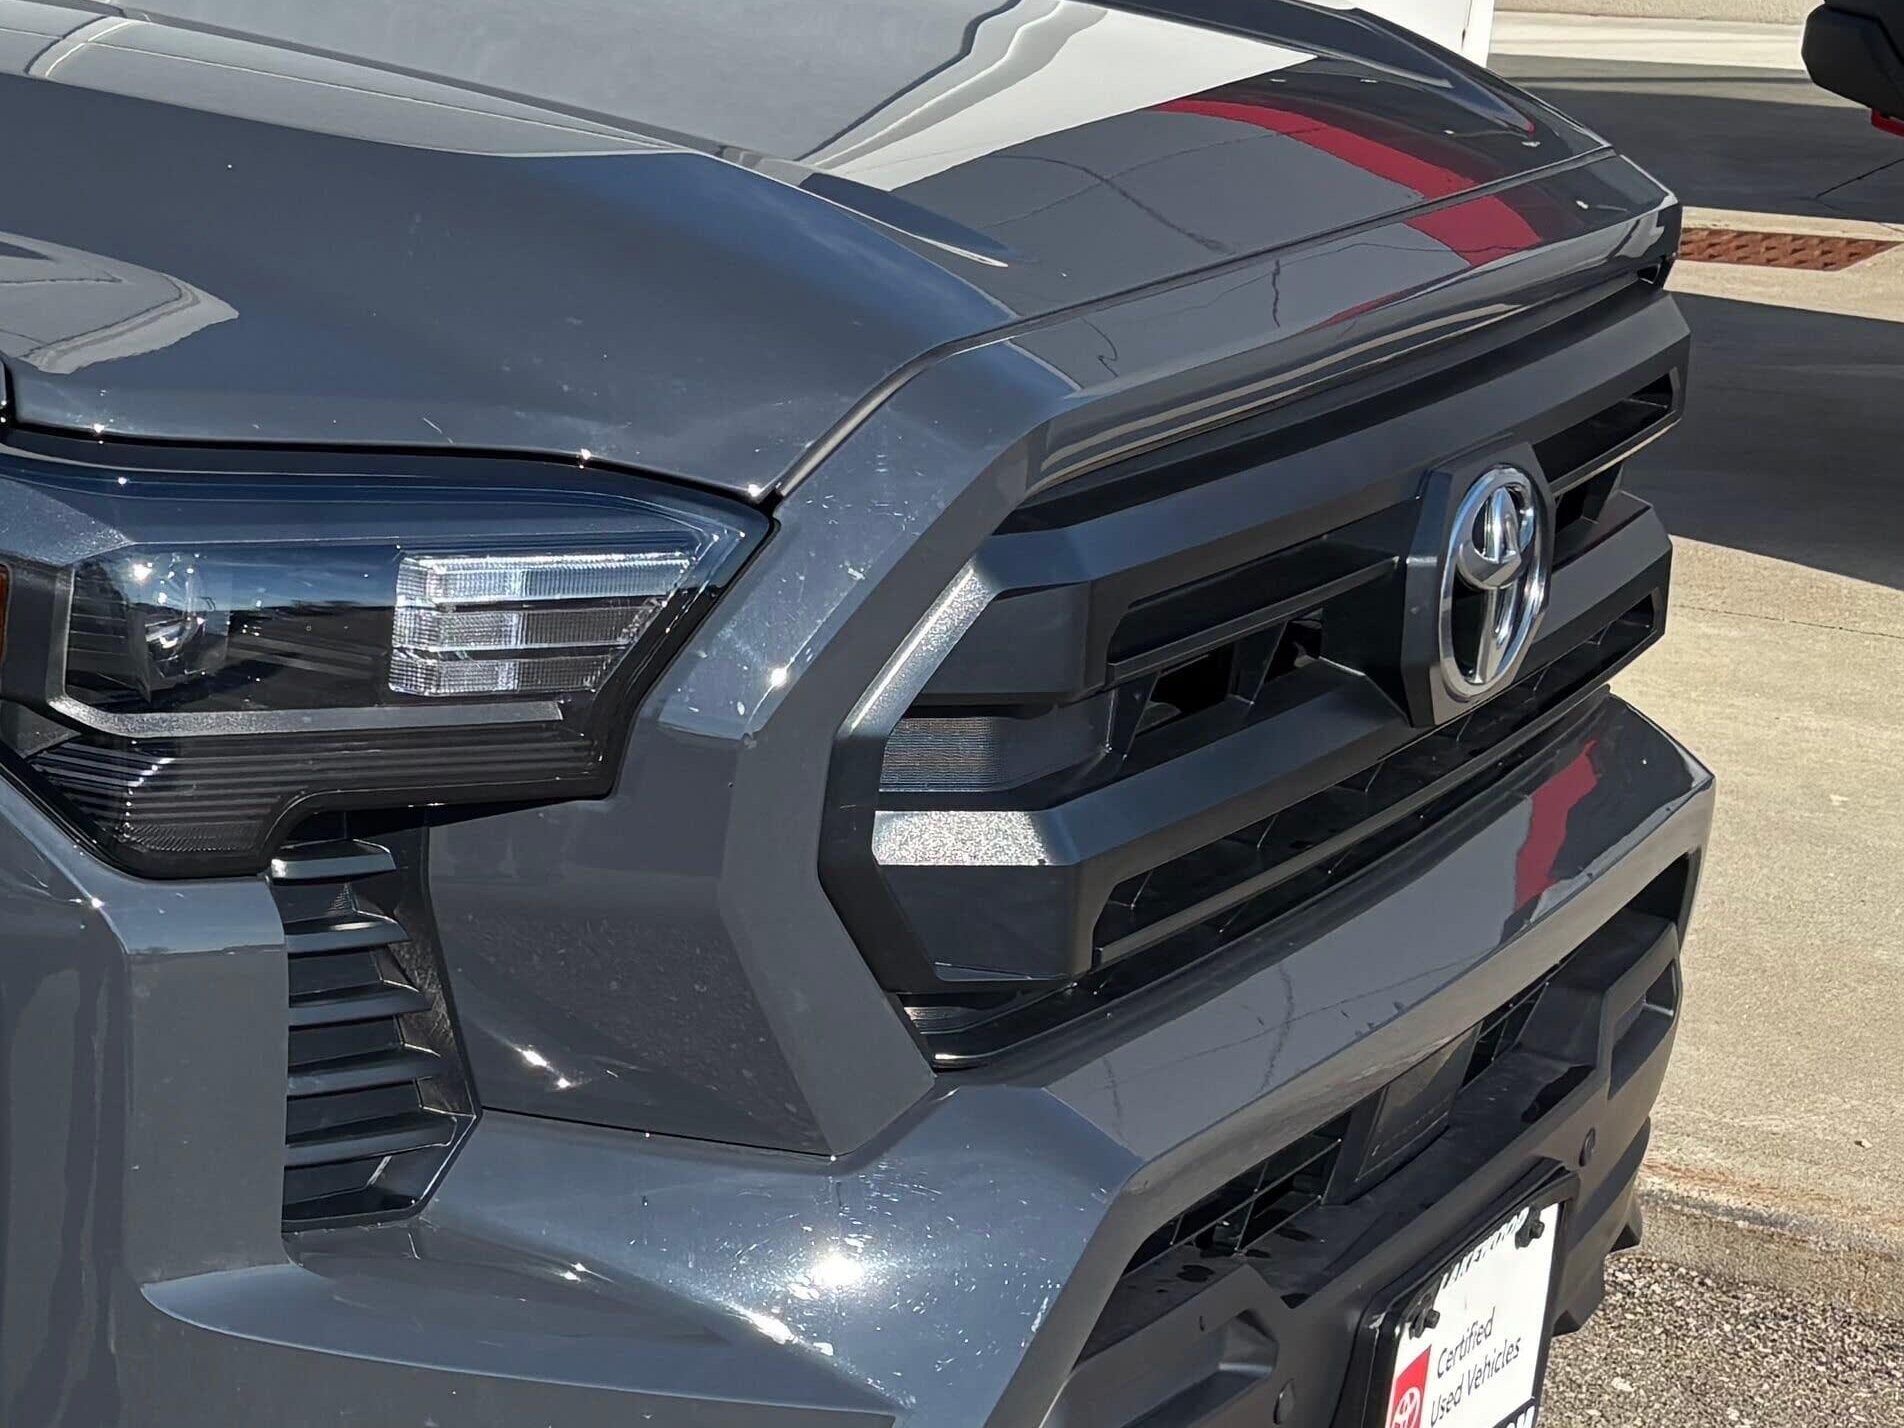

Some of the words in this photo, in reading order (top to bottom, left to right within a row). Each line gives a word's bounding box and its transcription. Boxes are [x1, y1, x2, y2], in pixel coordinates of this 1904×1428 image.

[1430, 1382, 1463, 1428] Used
[1466, 1336, 1521, 1400] Vehicles
[1438, 1306, 1496, 1379] Certified
